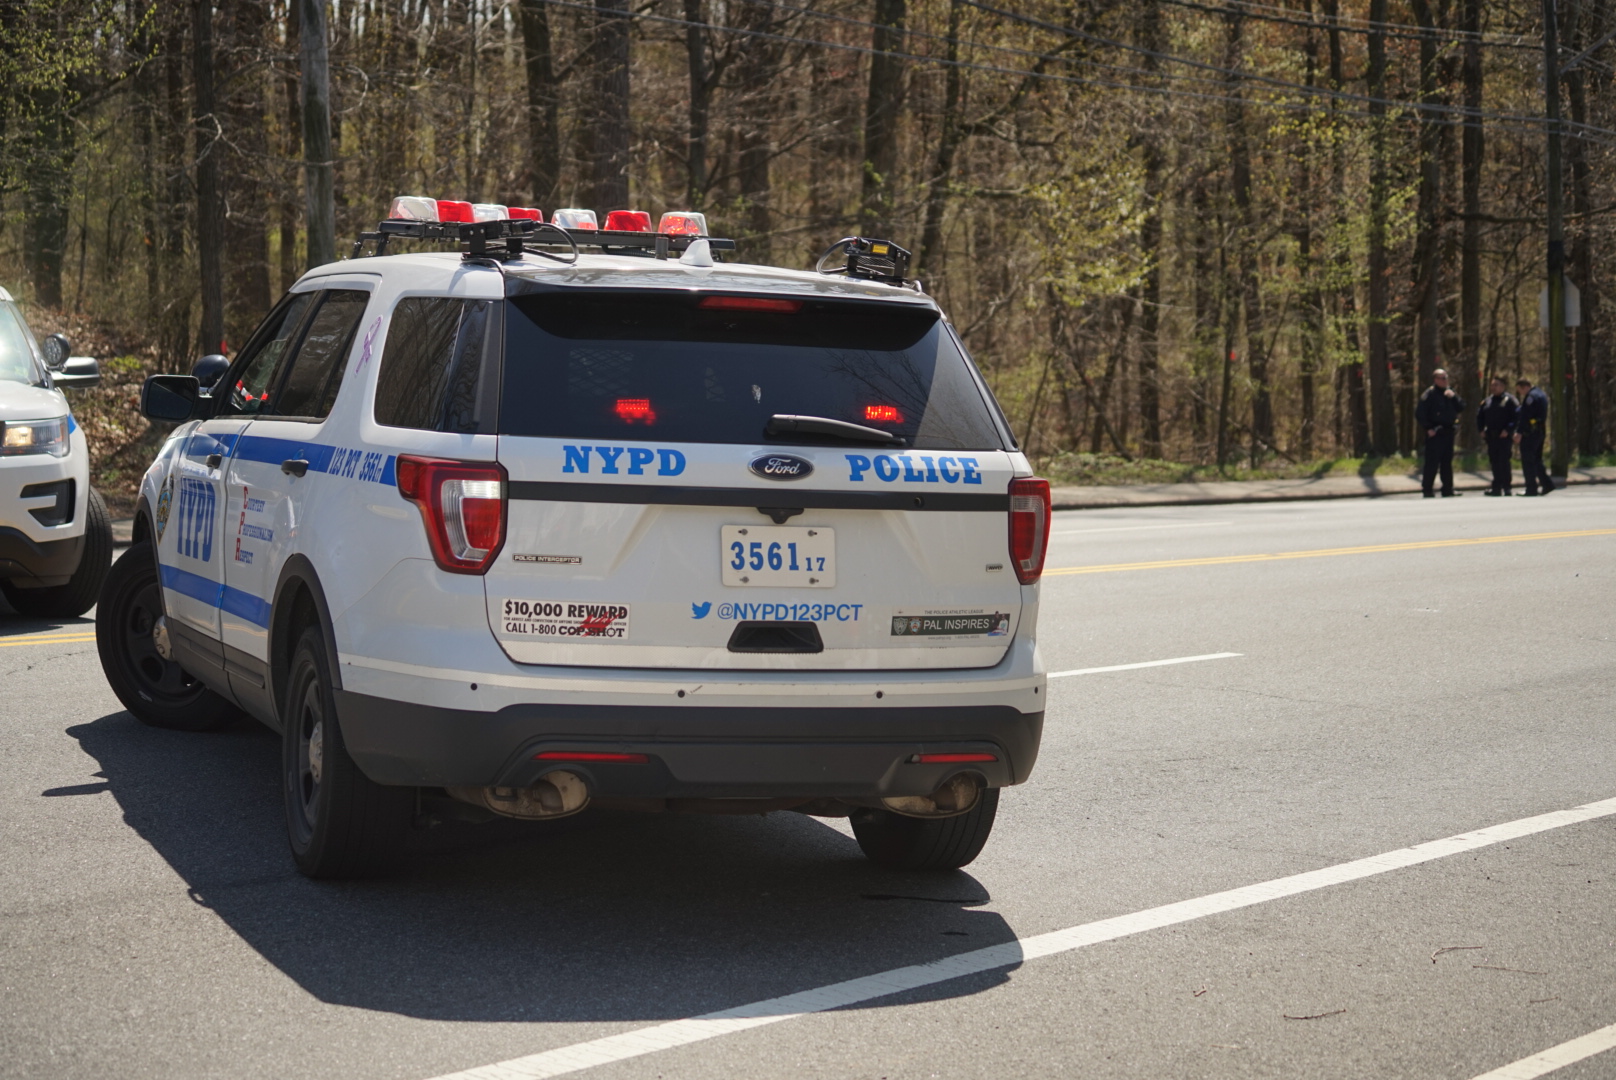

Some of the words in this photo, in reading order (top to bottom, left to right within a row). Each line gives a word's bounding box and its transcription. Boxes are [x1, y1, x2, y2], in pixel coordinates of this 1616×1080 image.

[329, 447, 347, 476] 123
[341, 448, 363, 479] PCT
[358, 451, 382, 482] 3561
[563, 445, 686, 477] NYPD
[764, 457, 800, 475] Ford
[845, 454, 982, 485] POLICE
[177, 477, 215, 562] NYPD
[730, 541, 799, 571] 3561
[805, 557, 826, 572] 17
[505, 599, 563, 618] $10,000
[567, 604, 628, 620] REWARD
[717, 602, 863, 622] @NYPD123PCT
[505, 622, 528, 634] CALL
[531, 623, 556, 635] 1-800
[923, 619, 942, 630] PAL
[944, 618, 990, 630] INSPIRES
